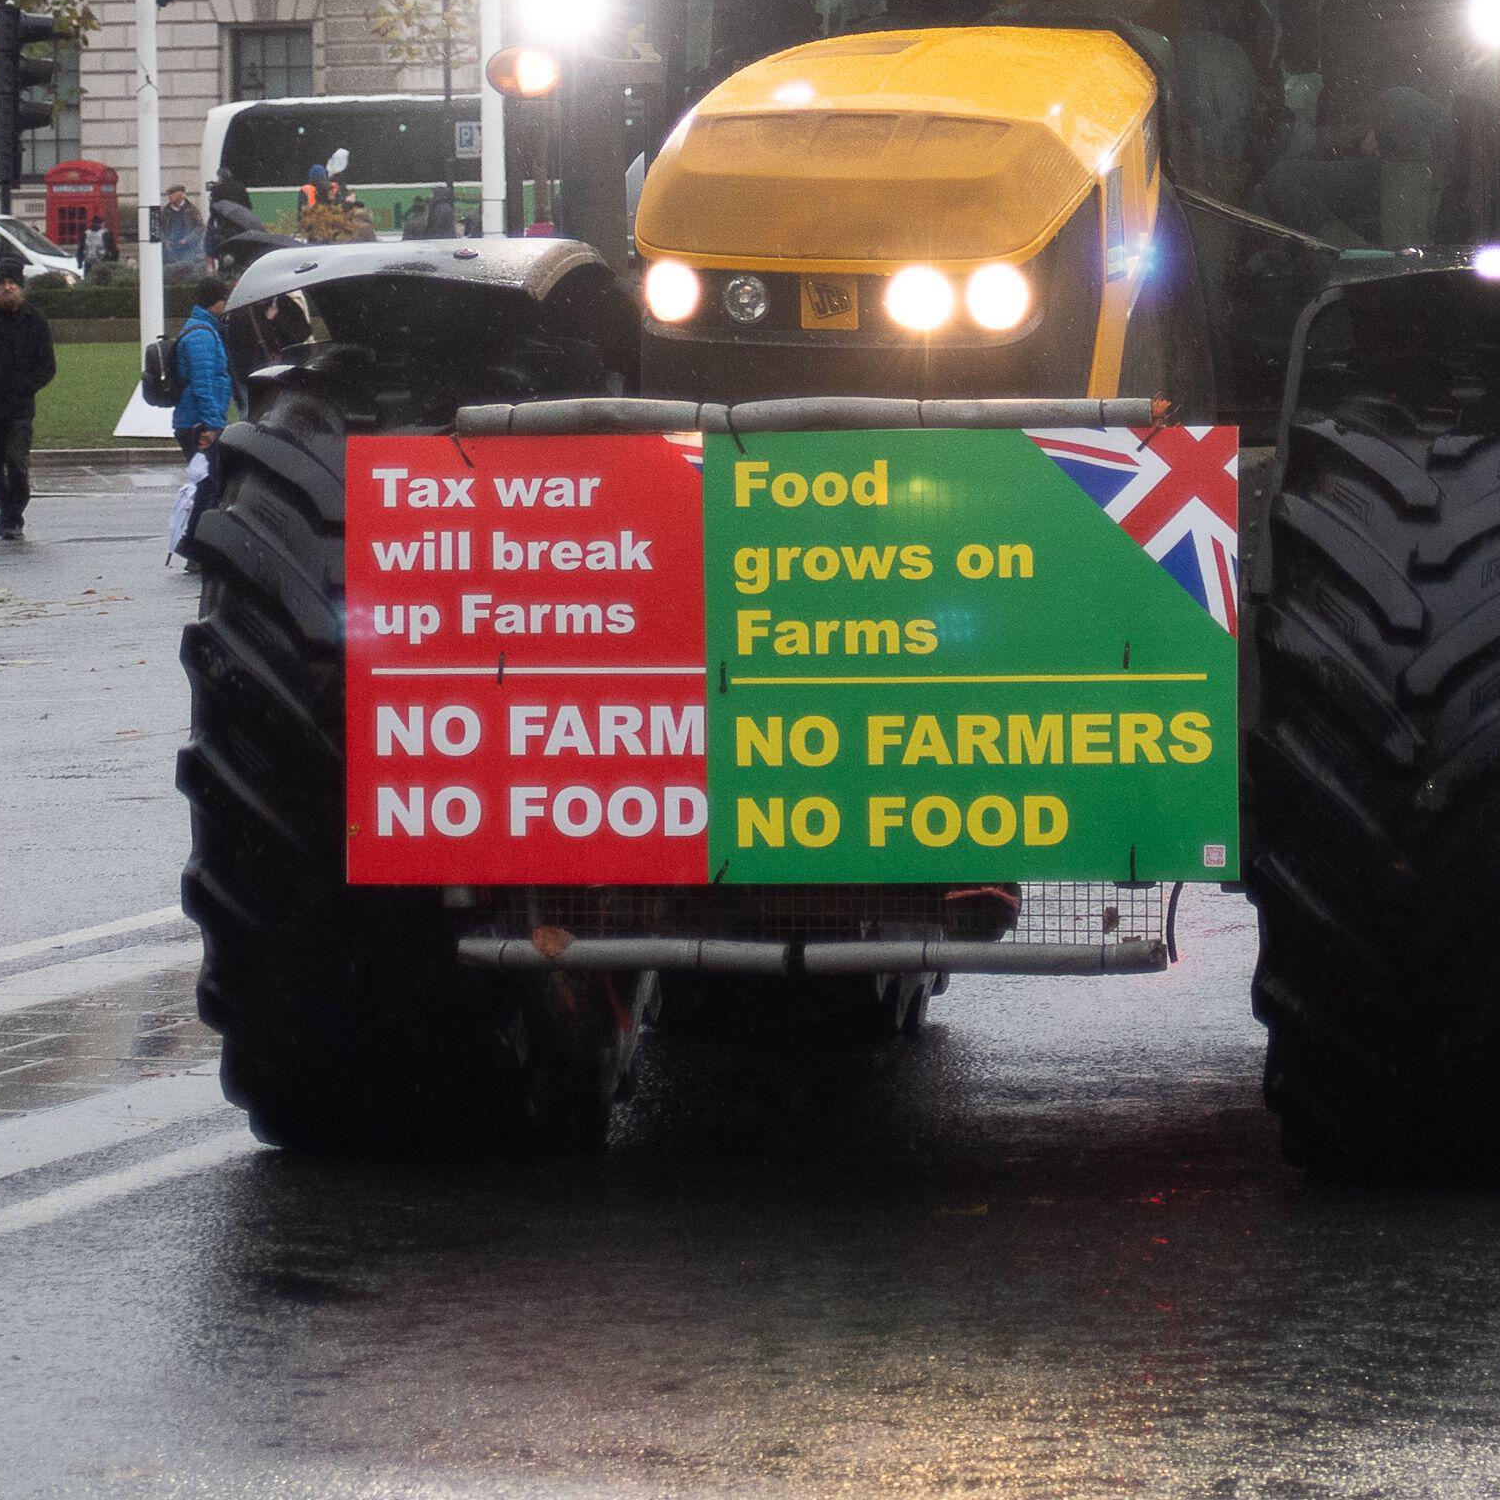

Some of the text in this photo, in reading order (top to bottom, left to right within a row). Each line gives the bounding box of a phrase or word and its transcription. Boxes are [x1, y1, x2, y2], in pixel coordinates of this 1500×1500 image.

[371, 467, 601, 509] Tax war
[734, 458, 891, 508] Food
[371, 530, 654, 571] will break
[733, 543, 1034, 595] grows on
[371, 594, 636, 645] up Farms
[736, 609, 939, 656] Farms
[376, 704, 706, 757] NO FARM
[735, 711, 1213, 767] NO FARMERS
[377, 785, 709, 838] NO FOOD
[736, 794, 1070, 848] NO FOOD
